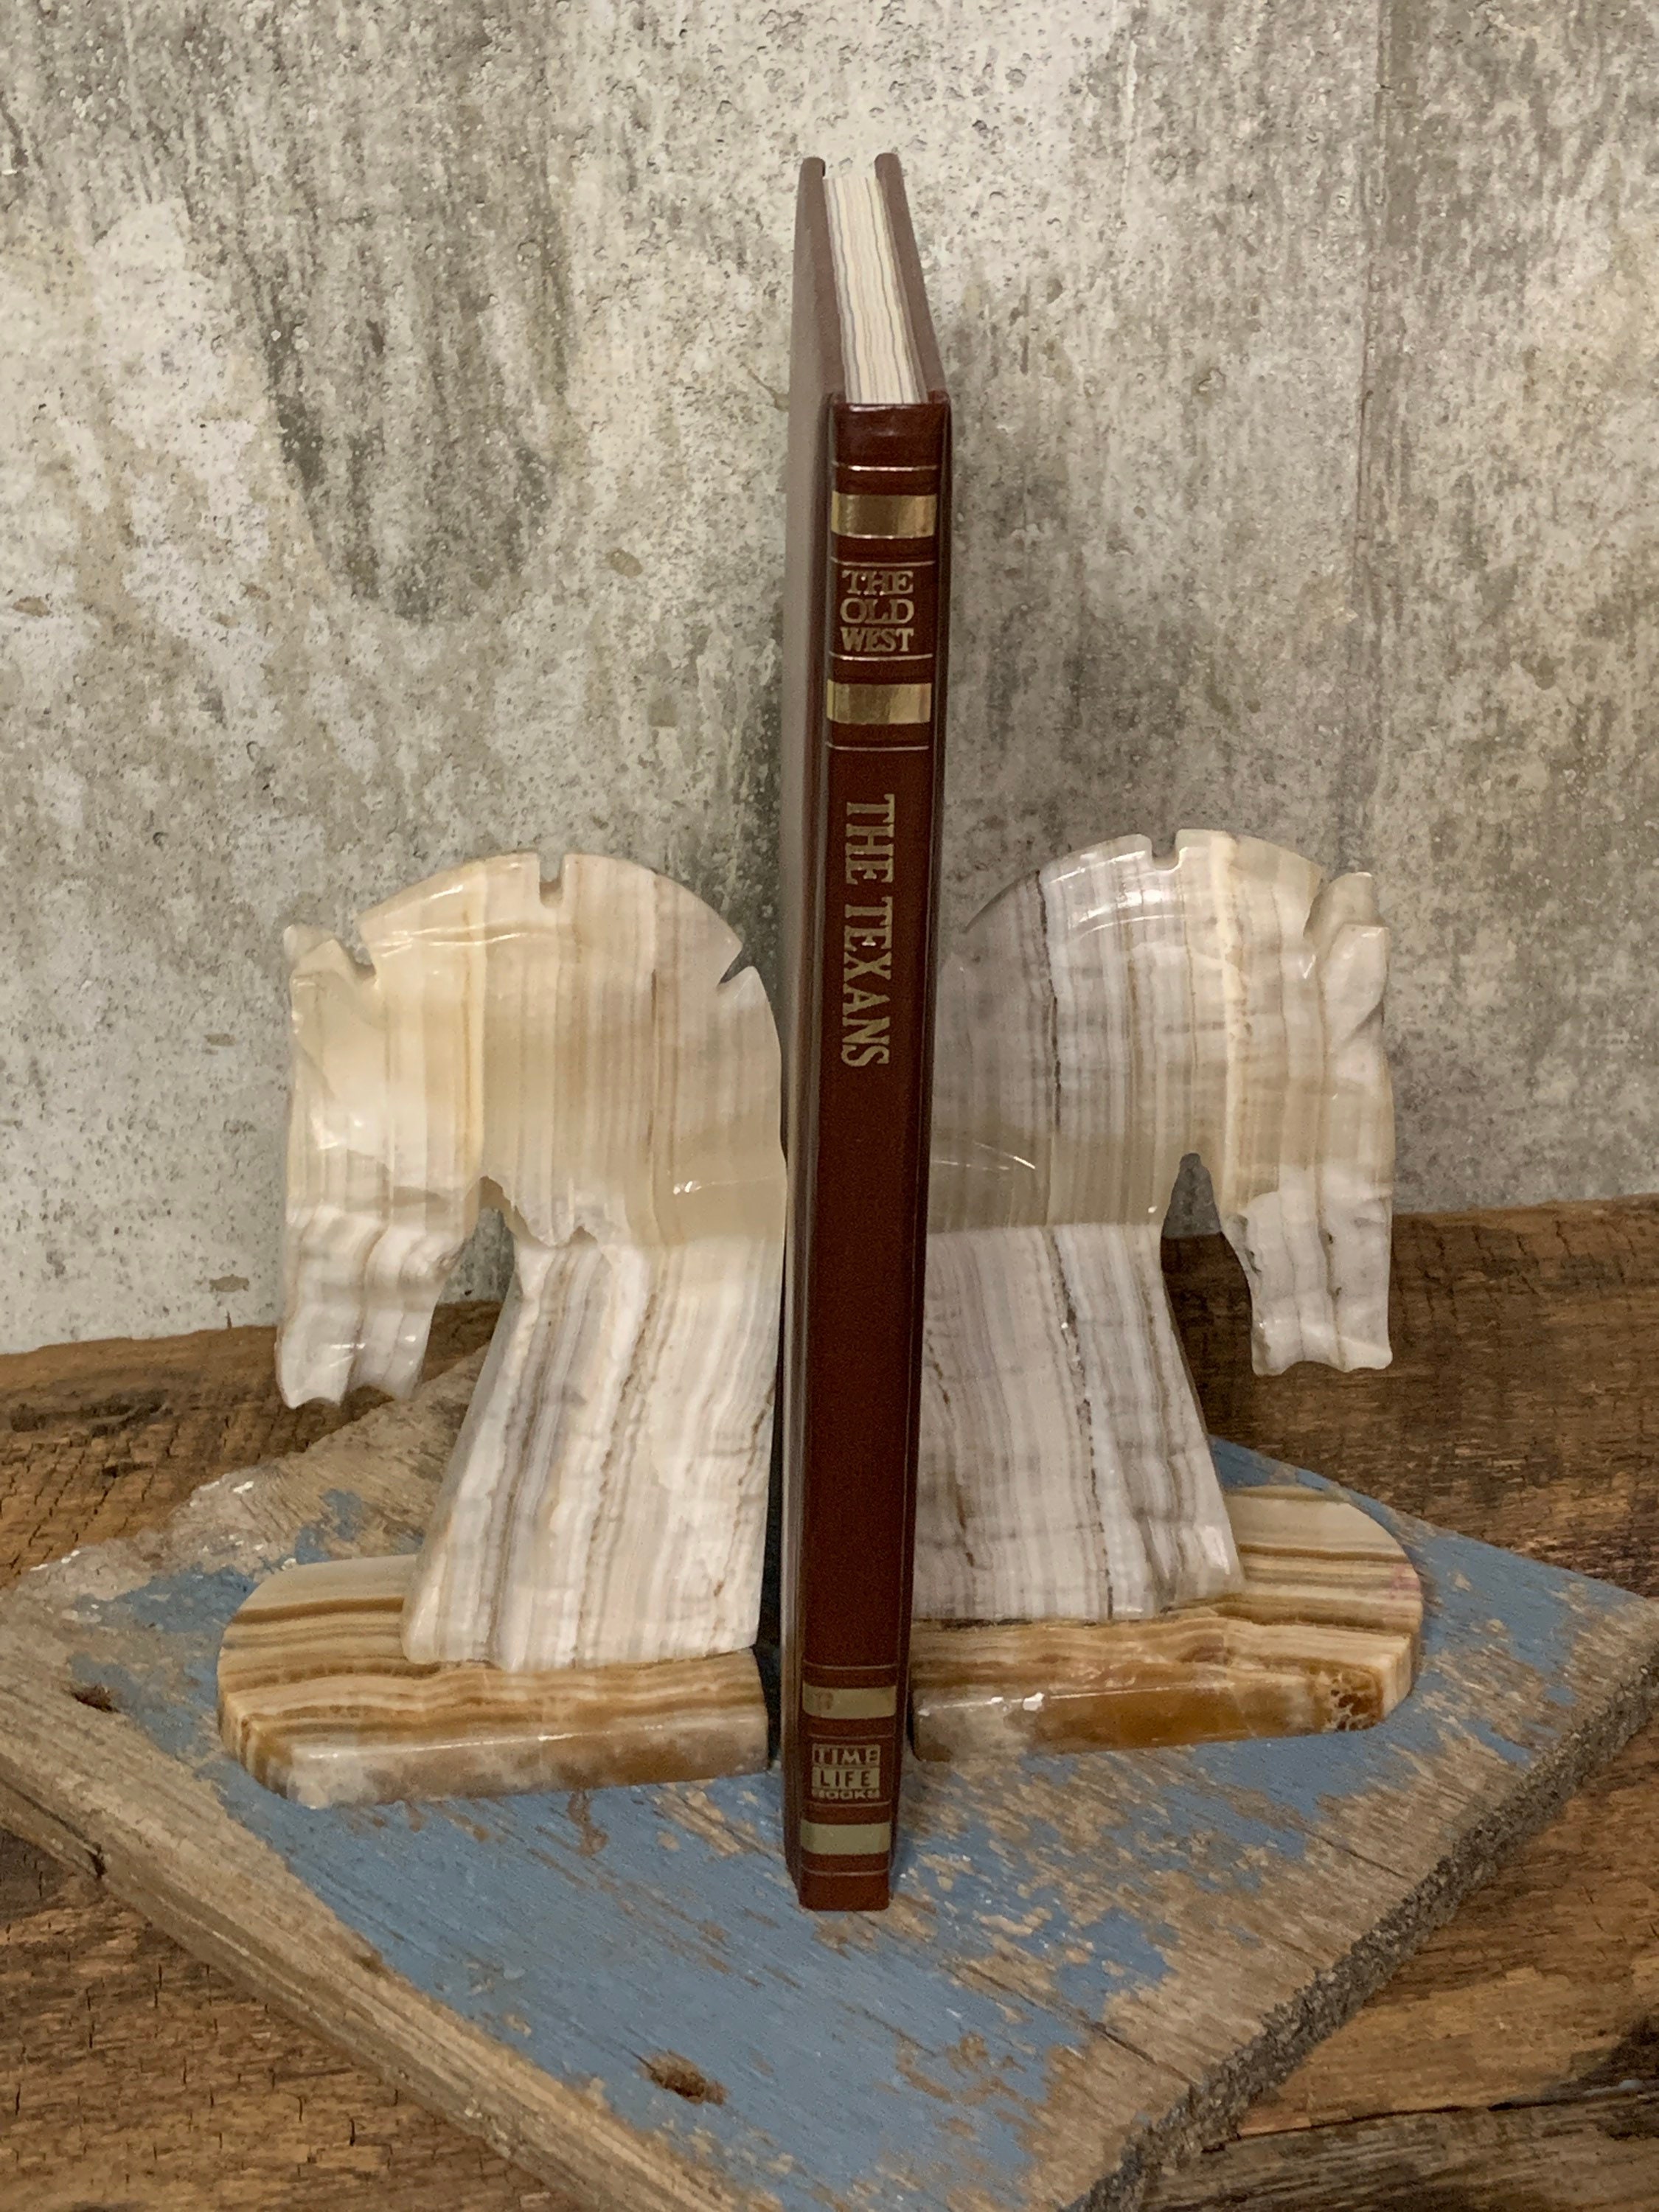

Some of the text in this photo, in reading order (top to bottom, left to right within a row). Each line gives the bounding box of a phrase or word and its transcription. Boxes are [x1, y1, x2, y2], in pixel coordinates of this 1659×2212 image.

[841, 570, 914, 595] THE
[840, 598, 914, 624] OLD
[840, 627, 914, 652] WEST
[841, 793, 895, 1067] THE TEXANS
[821, 1770, 870, 1787] LIFE
